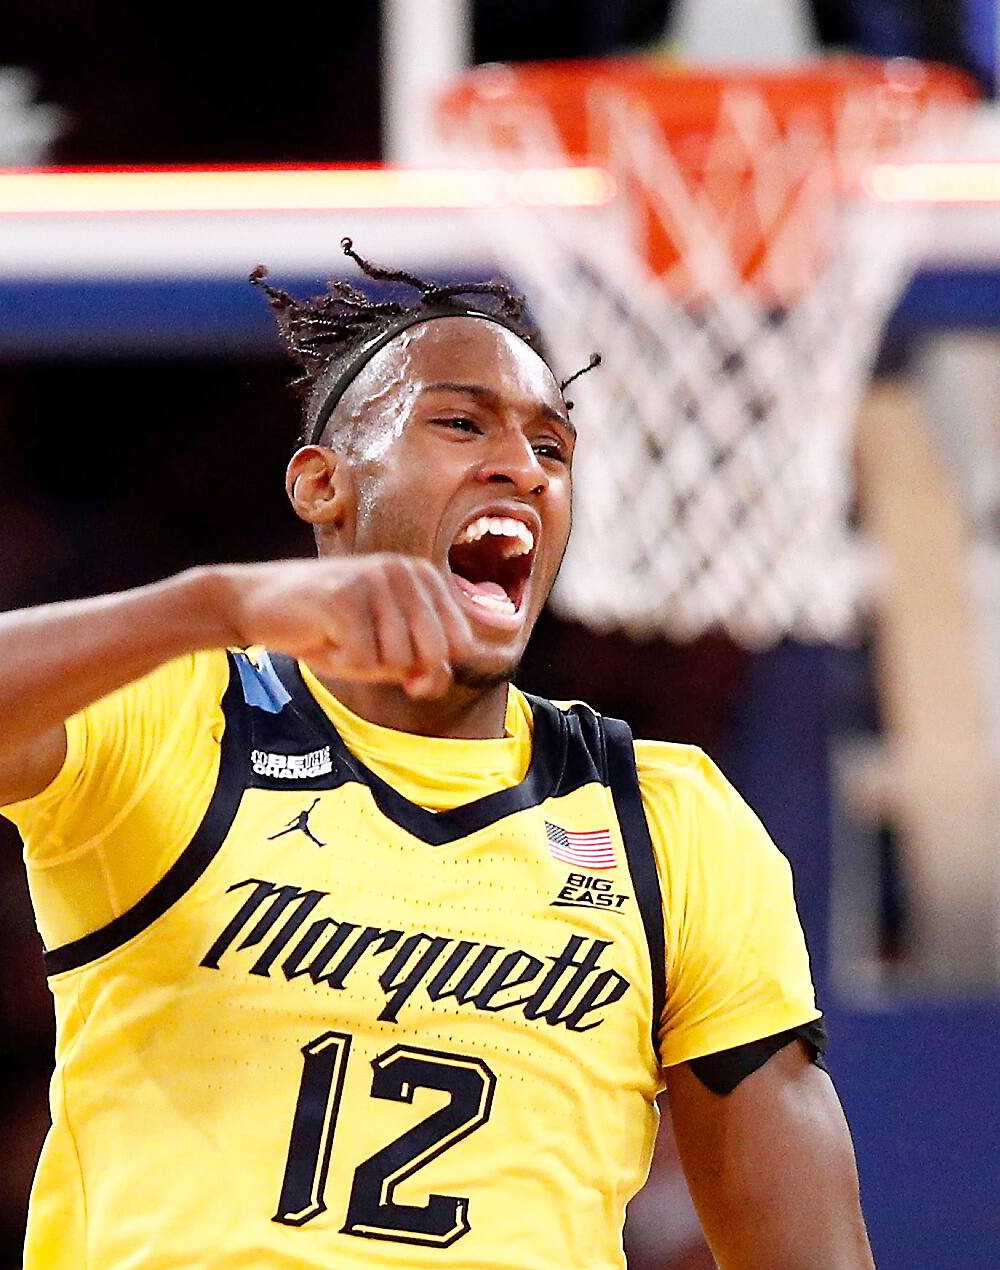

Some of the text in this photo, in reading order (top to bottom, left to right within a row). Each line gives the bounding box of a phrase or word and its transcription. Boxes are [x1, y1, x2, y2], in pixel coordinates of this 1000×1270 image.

[557, 886, 630, 908] EAST
[566, 872, 614, 892] BIG
[198, 877, 631, 1033] Marquette
[271, 1031, 498, 1249] 12
